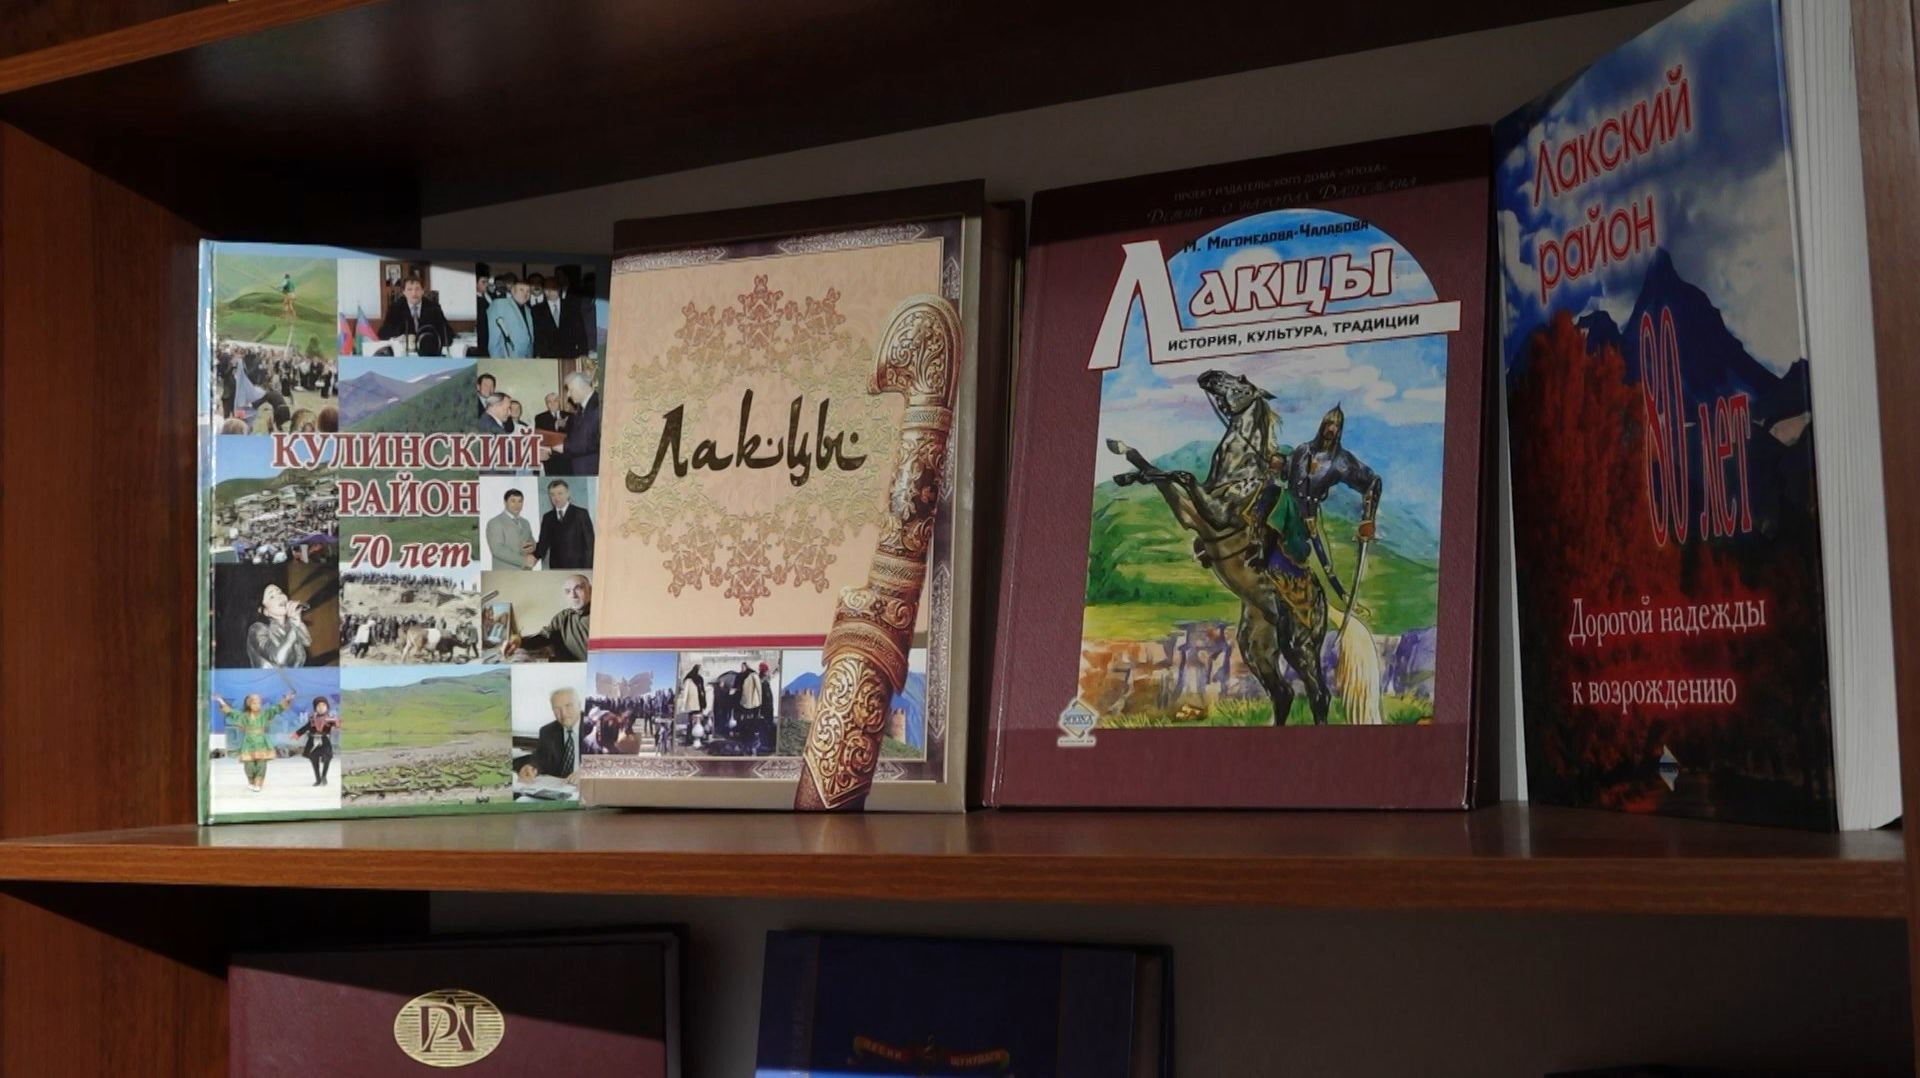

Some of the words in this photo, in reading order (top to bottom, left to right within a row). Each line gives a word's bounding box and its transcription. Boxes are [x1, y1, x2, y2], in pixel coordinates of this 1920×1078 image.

[1533, 64, 1691, 207] Лакский
[1184, 239, 1202, 253] М.
[1539, 195, 1656, 304] район
[1088, 239, 1394, 370] Лакцы
[1167, 332, 1243, 352] ИСТОРИЯ,
[1246, 324, 1329, 344] КУЛЬТУРА,
[1332, 313, 1421, 335] ТРАДИЦИИ
[272, 428, 543, 470] КУЛИНСКИЙ
[625, 388, 868, 493] Лакцы
[1639, 305, 1689, 548] 80
[1698, 392, 1752, 541] лет
[338, 473, 480, 515] РАЙОН
[351, 535, 391, 568] 70
[400, 541, 472, 568] лет
[1568, 595, 1654, 648] Дорогой
[1659, 598, 1767, 637] надежды
[1571, 680, 1585, 705] к
[1588, 677, 1738, 716] возрождению
